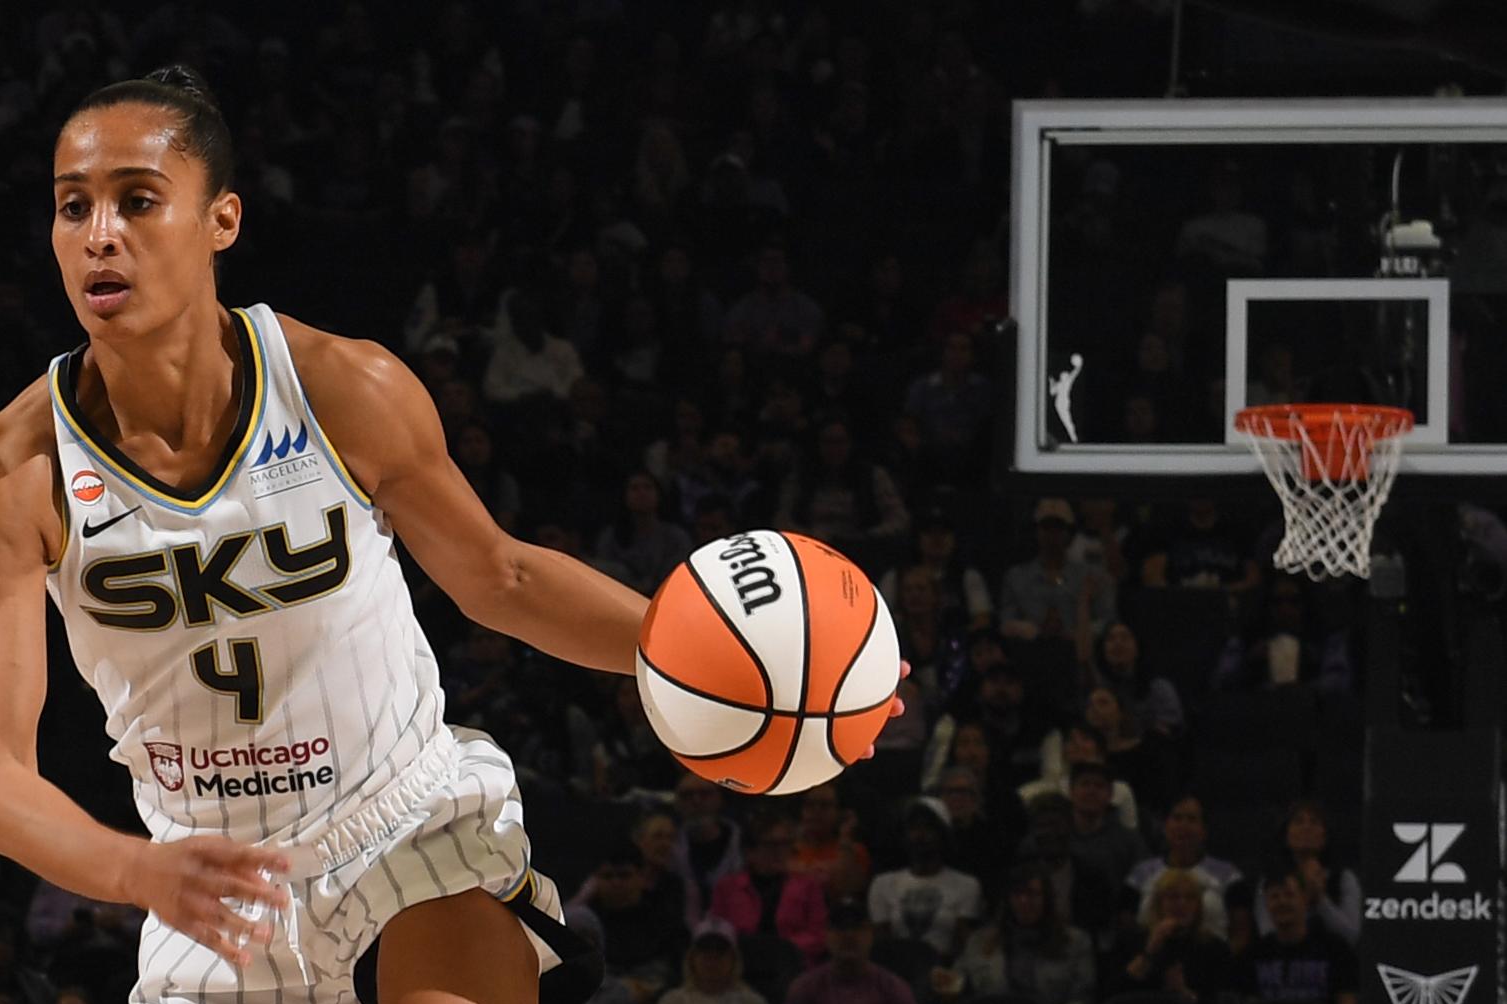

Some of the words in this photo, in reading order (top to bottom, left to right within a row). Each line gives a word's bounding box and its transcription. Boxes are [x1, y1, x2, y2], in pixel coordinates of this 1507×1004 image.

[249, 457, 319, 485] MAGELLAN
[79, 500, 352, 632] SKY
[190, 637, 263, 725] 4
[194, 766, 333, 797] Medicine
[1365, 891, 1492, 920] zendesk
